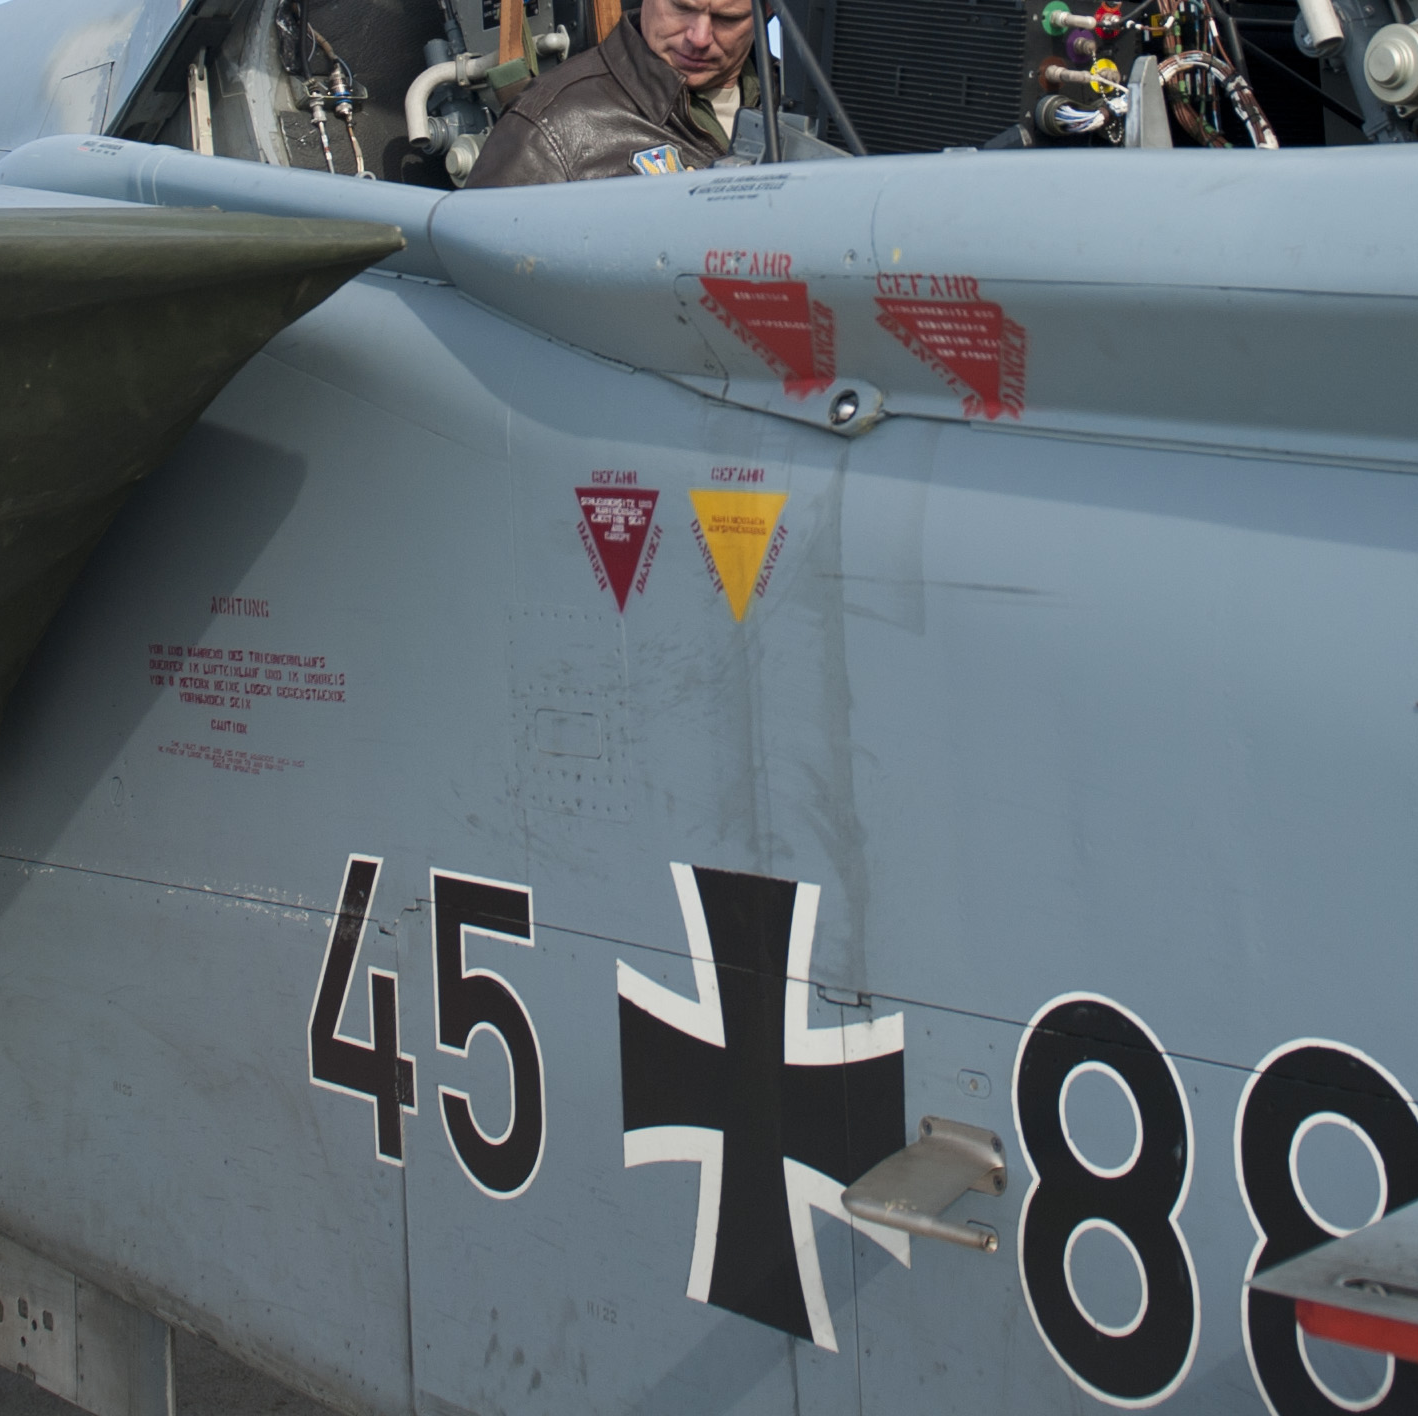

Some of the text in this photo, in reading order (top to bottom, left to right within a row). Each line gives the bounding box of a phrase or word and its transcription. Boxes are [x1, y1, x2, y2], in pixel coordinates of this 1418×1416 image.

[704, 249, 793, 279] GEFAHR
[876, 273, 981, 301] GEFAHR
[711, 465, 765, 483] GEFAHR
[210, 596, 269, 618] ACHTUNG
[210, 718, 247, 735] CAUTION
[308, 850, 547, 1200] 45
